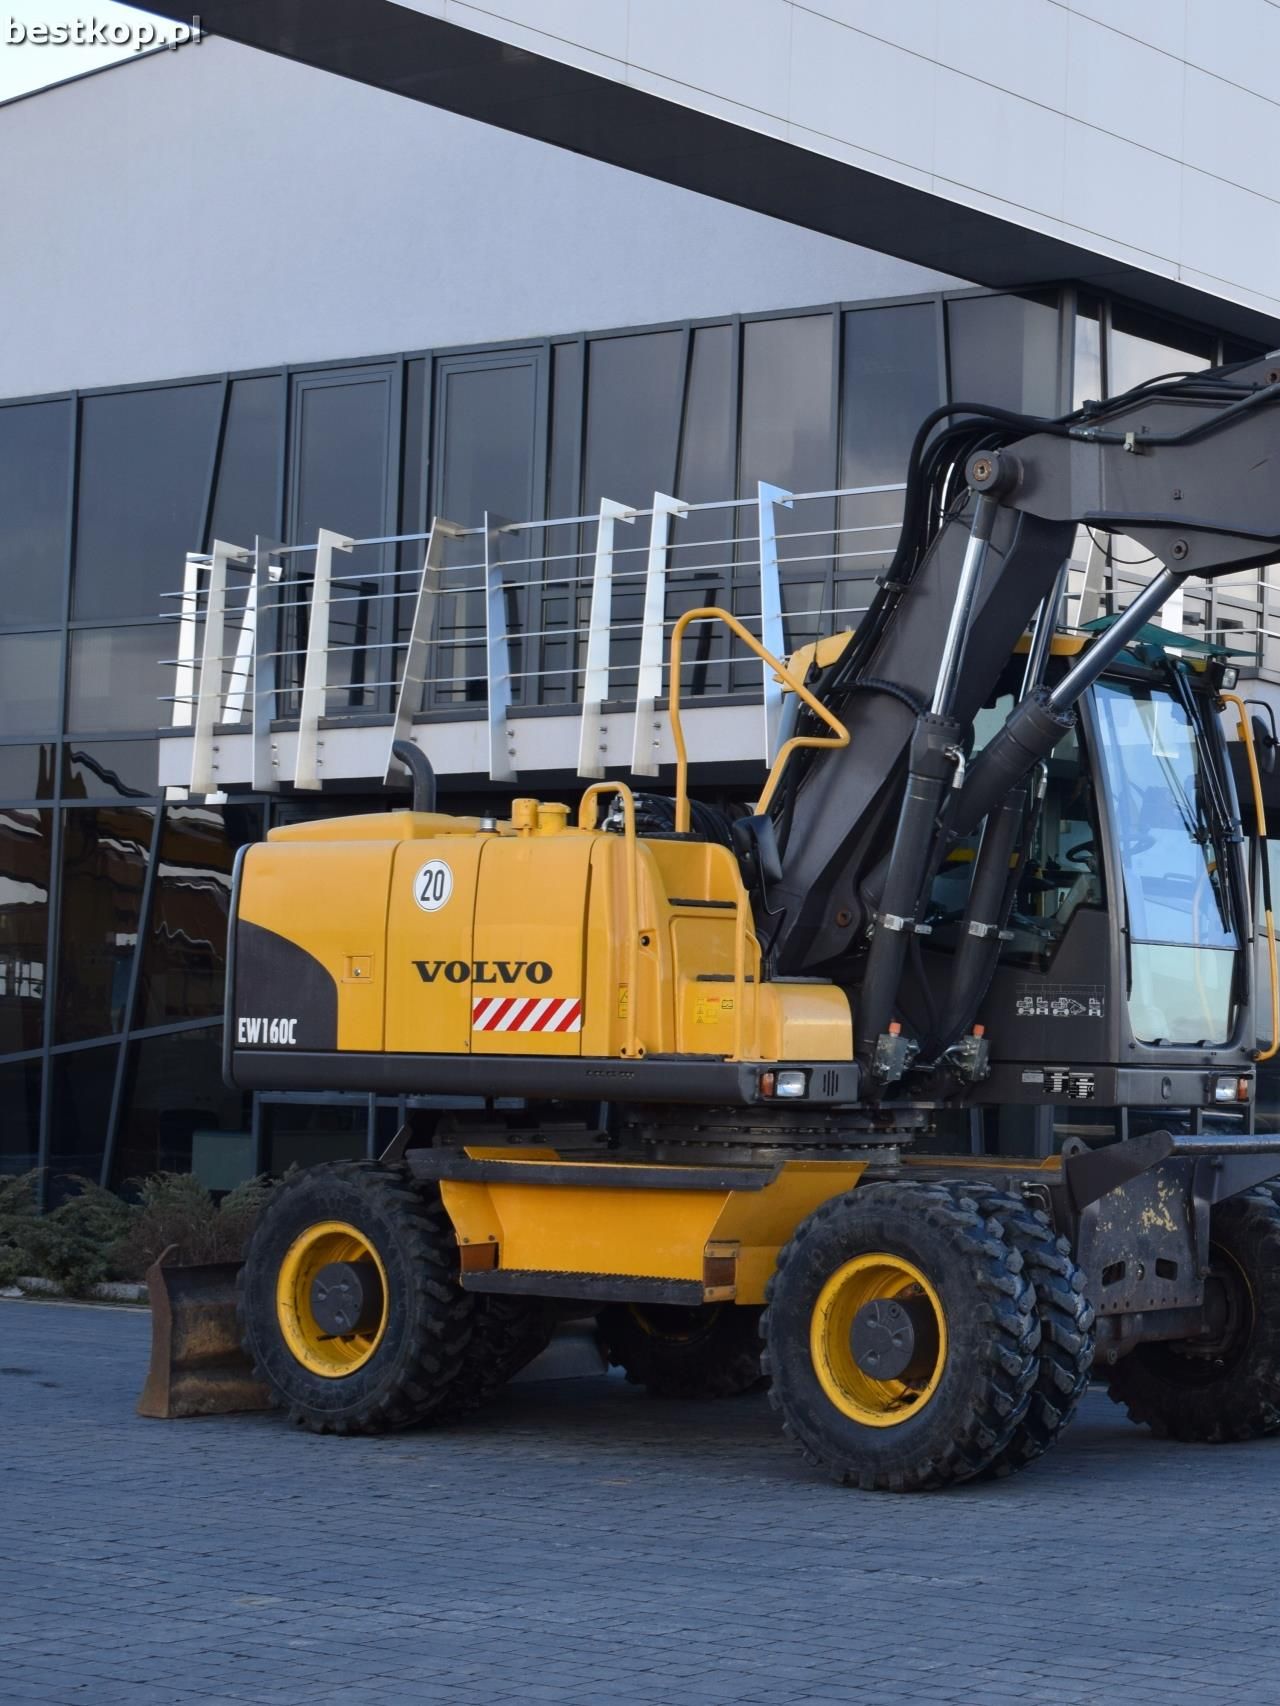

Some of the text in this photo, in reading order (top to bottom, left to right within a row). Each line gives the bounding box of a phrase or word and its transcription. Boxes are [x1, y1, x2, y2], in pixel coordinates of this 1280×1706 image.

[420, 869, 445, 902] 20
[411, 960, 553, 984] VOLVO
[238, 1017, 298, 1045] EW160C
